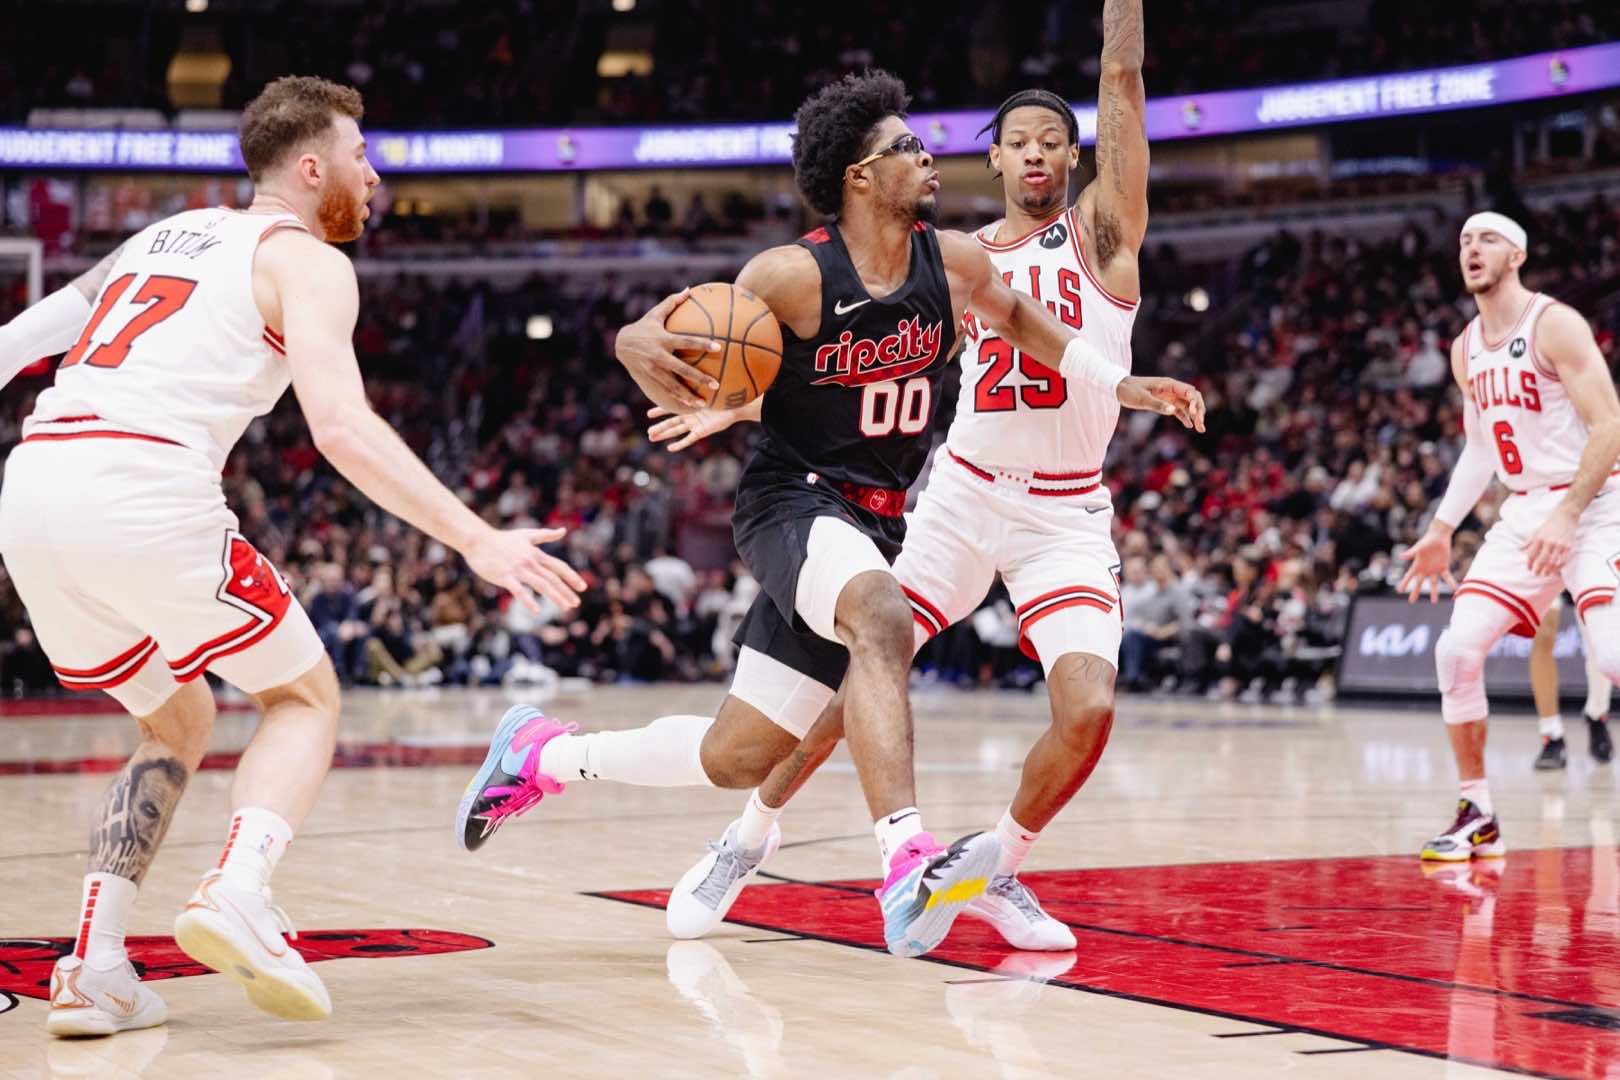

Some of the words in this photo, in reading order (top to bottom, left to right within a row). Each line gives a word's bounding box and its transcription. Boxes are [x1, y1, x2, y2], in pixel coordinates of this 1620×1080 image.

[1380, 73, 1436, 111] FREE
[1437, 67, 1496, 105] ZONE
[117, 131, 173, 165] FREE
[175, 133, 232, 166] ZONE
[58, 272, 199, 369] 17
[812, 314, 942, 385] ripcity
[859, 376, 931, 438] 00
[1493, 420, 1523, 475] 6
